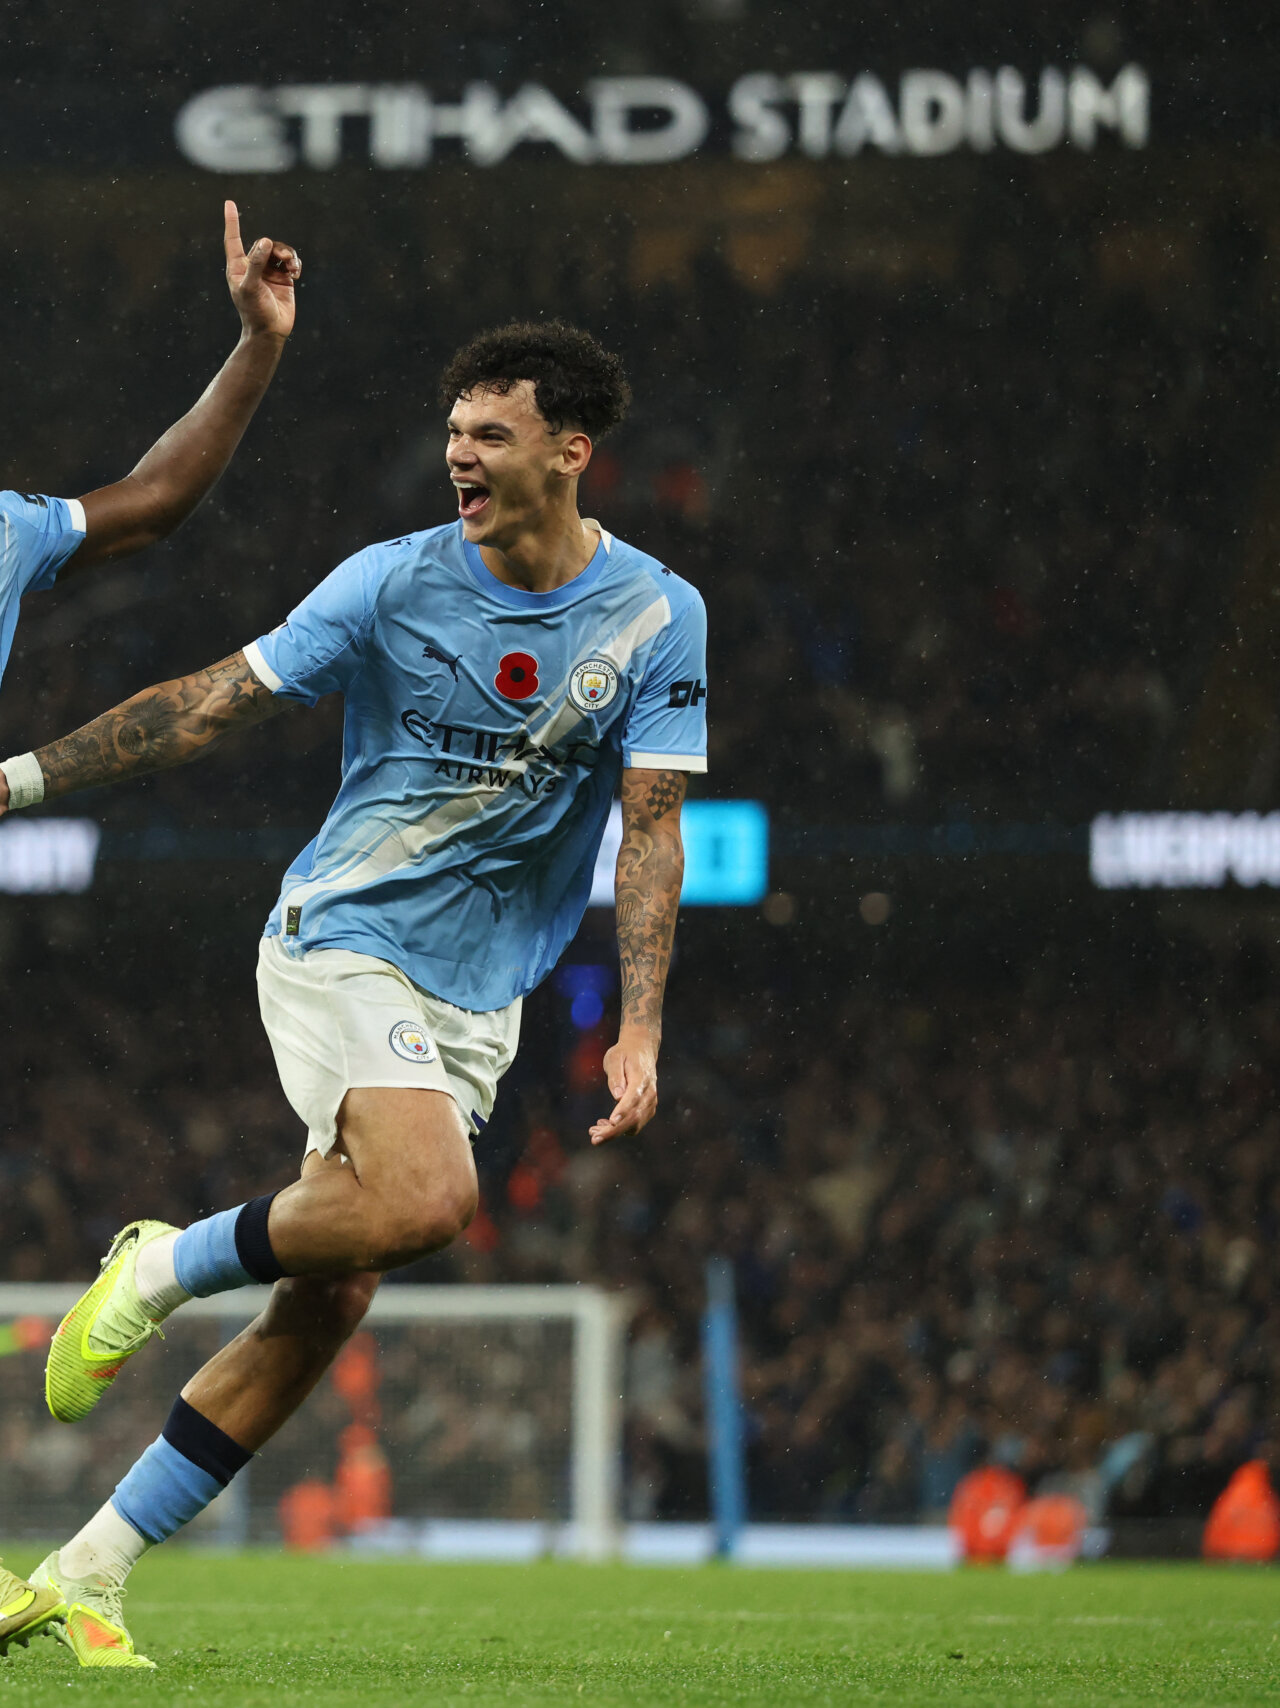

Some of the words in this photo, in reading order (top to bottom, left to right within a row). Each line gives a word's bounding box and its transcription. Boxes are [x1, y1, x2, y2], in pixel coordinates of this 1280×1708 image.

[175, 78, 709, 173] ETIHAD
[731, 65, 1151, 162] STADIUM
[574, 663, 616, 681] MANCHESTER
[434, 760, 562, 794] AIRWAYS
